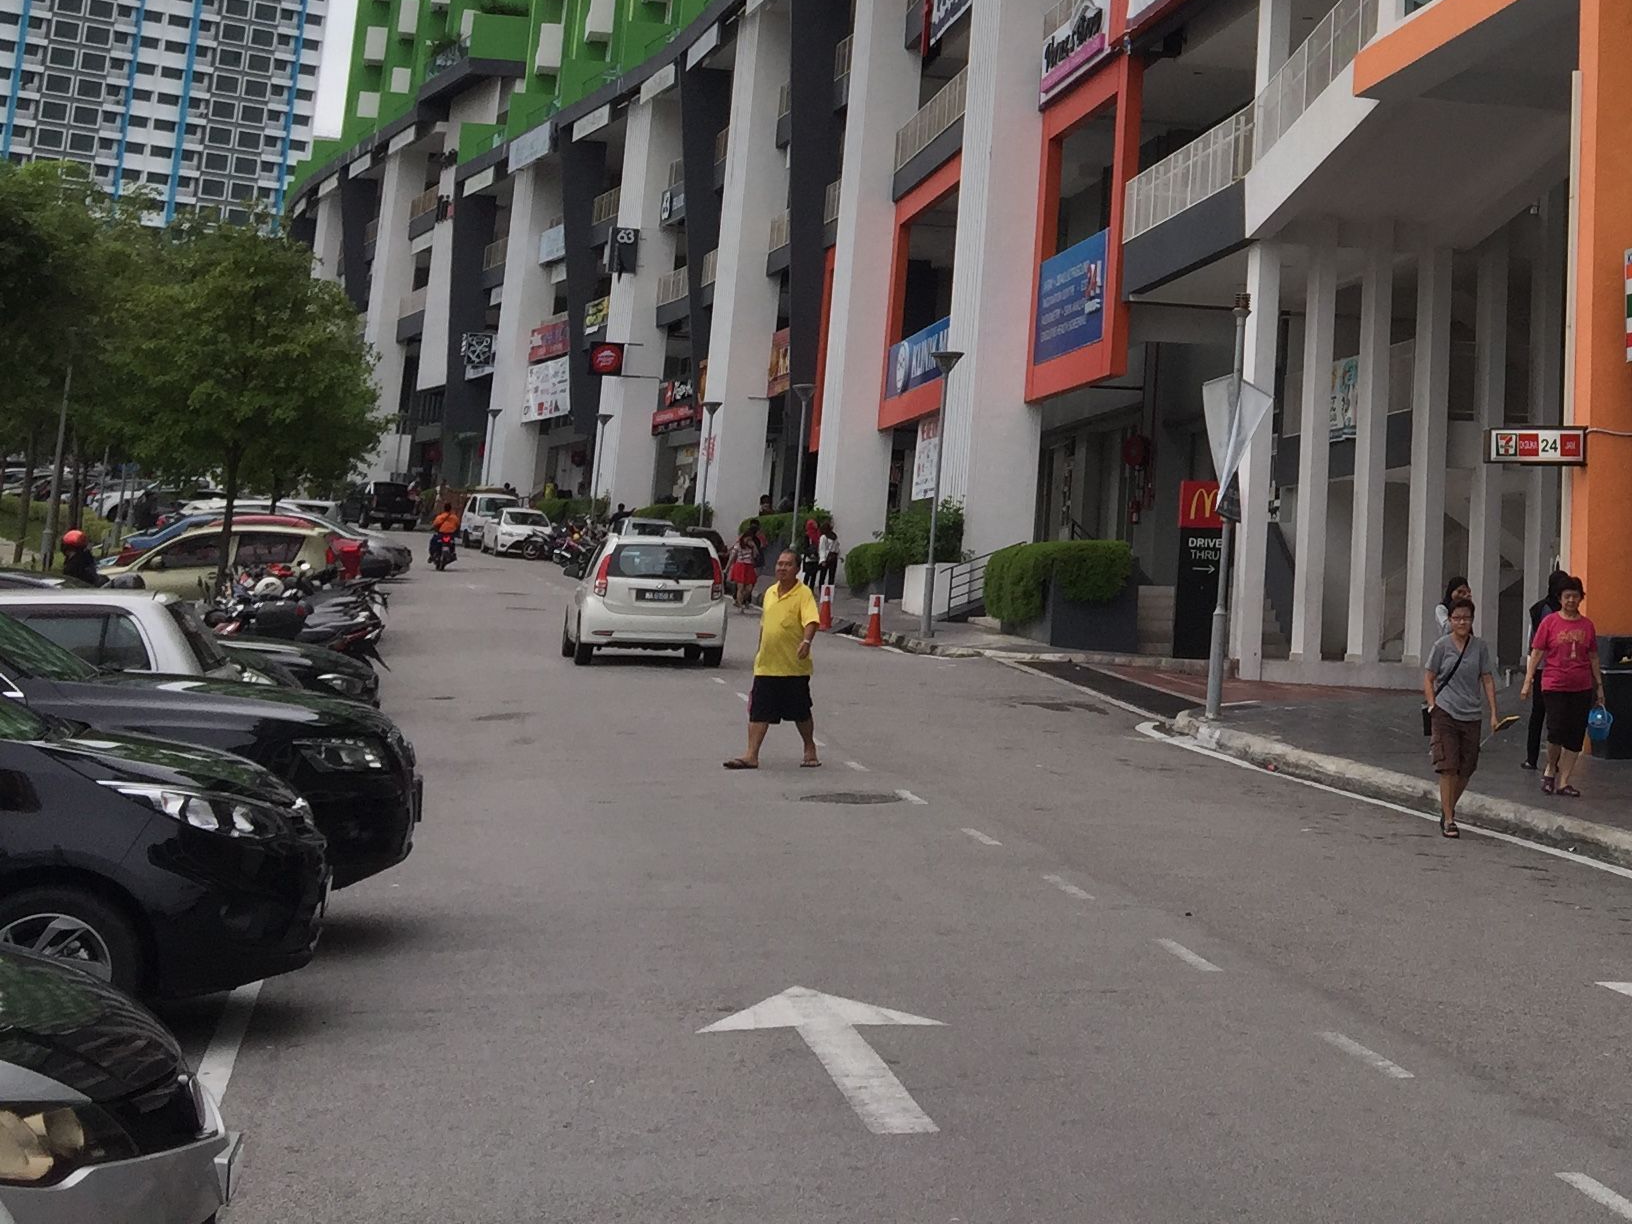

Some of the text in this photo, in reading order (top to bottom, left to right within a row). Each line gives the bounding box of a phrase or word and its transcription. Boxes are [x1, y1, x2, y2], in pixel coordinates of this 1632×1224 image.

[617, 229, 634, 244] 63
[1541, 438, 1559, 453] 24
[1188, 537, 1223, 549] DRIVE
[1190, 549, 1221, 561] THRU
